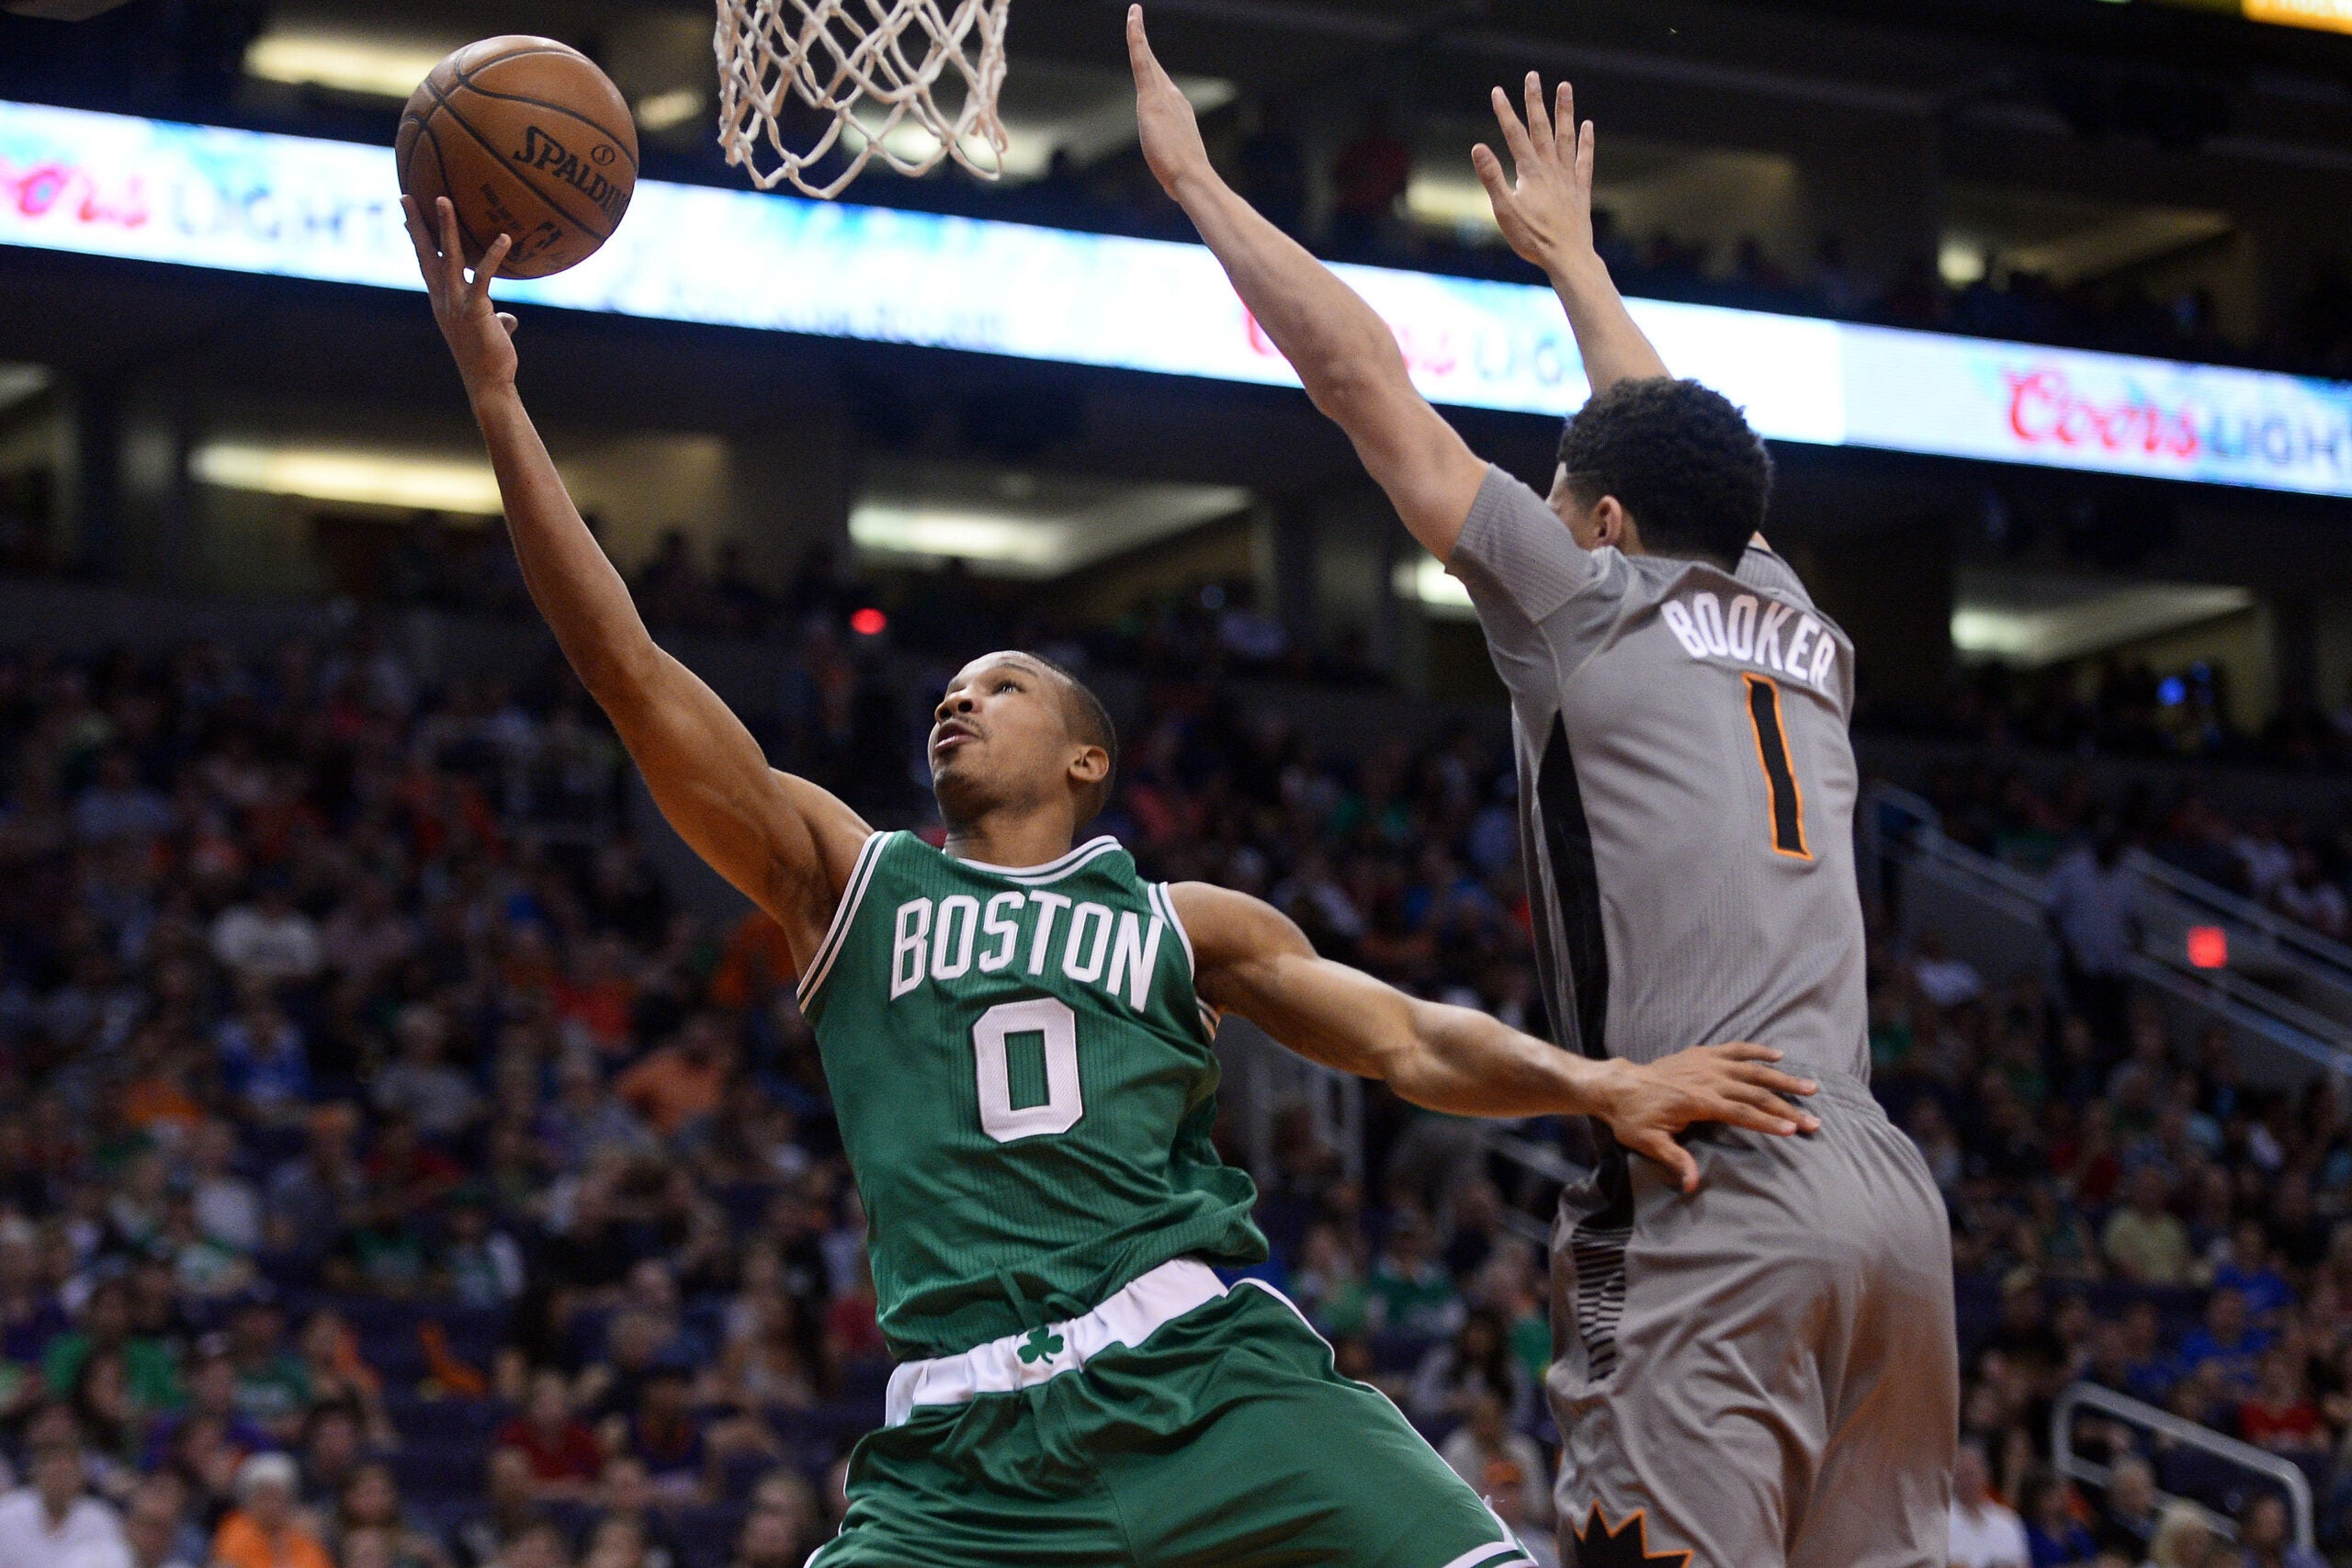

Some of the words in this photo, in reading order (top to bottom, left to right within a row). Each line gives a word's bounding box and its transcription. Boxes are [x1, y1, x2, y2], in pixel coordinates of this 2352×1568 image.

[2003, 367, 2199, 459] Coors
[2209, 412, 2352, 470] LIGH
[1660, 592, 1836, 695] BOOKER
[1741, 671, 1815, 862] 1
[889, 890, 1165, 1013] BOSTON
[972, 997, 1084, 1144] 0
